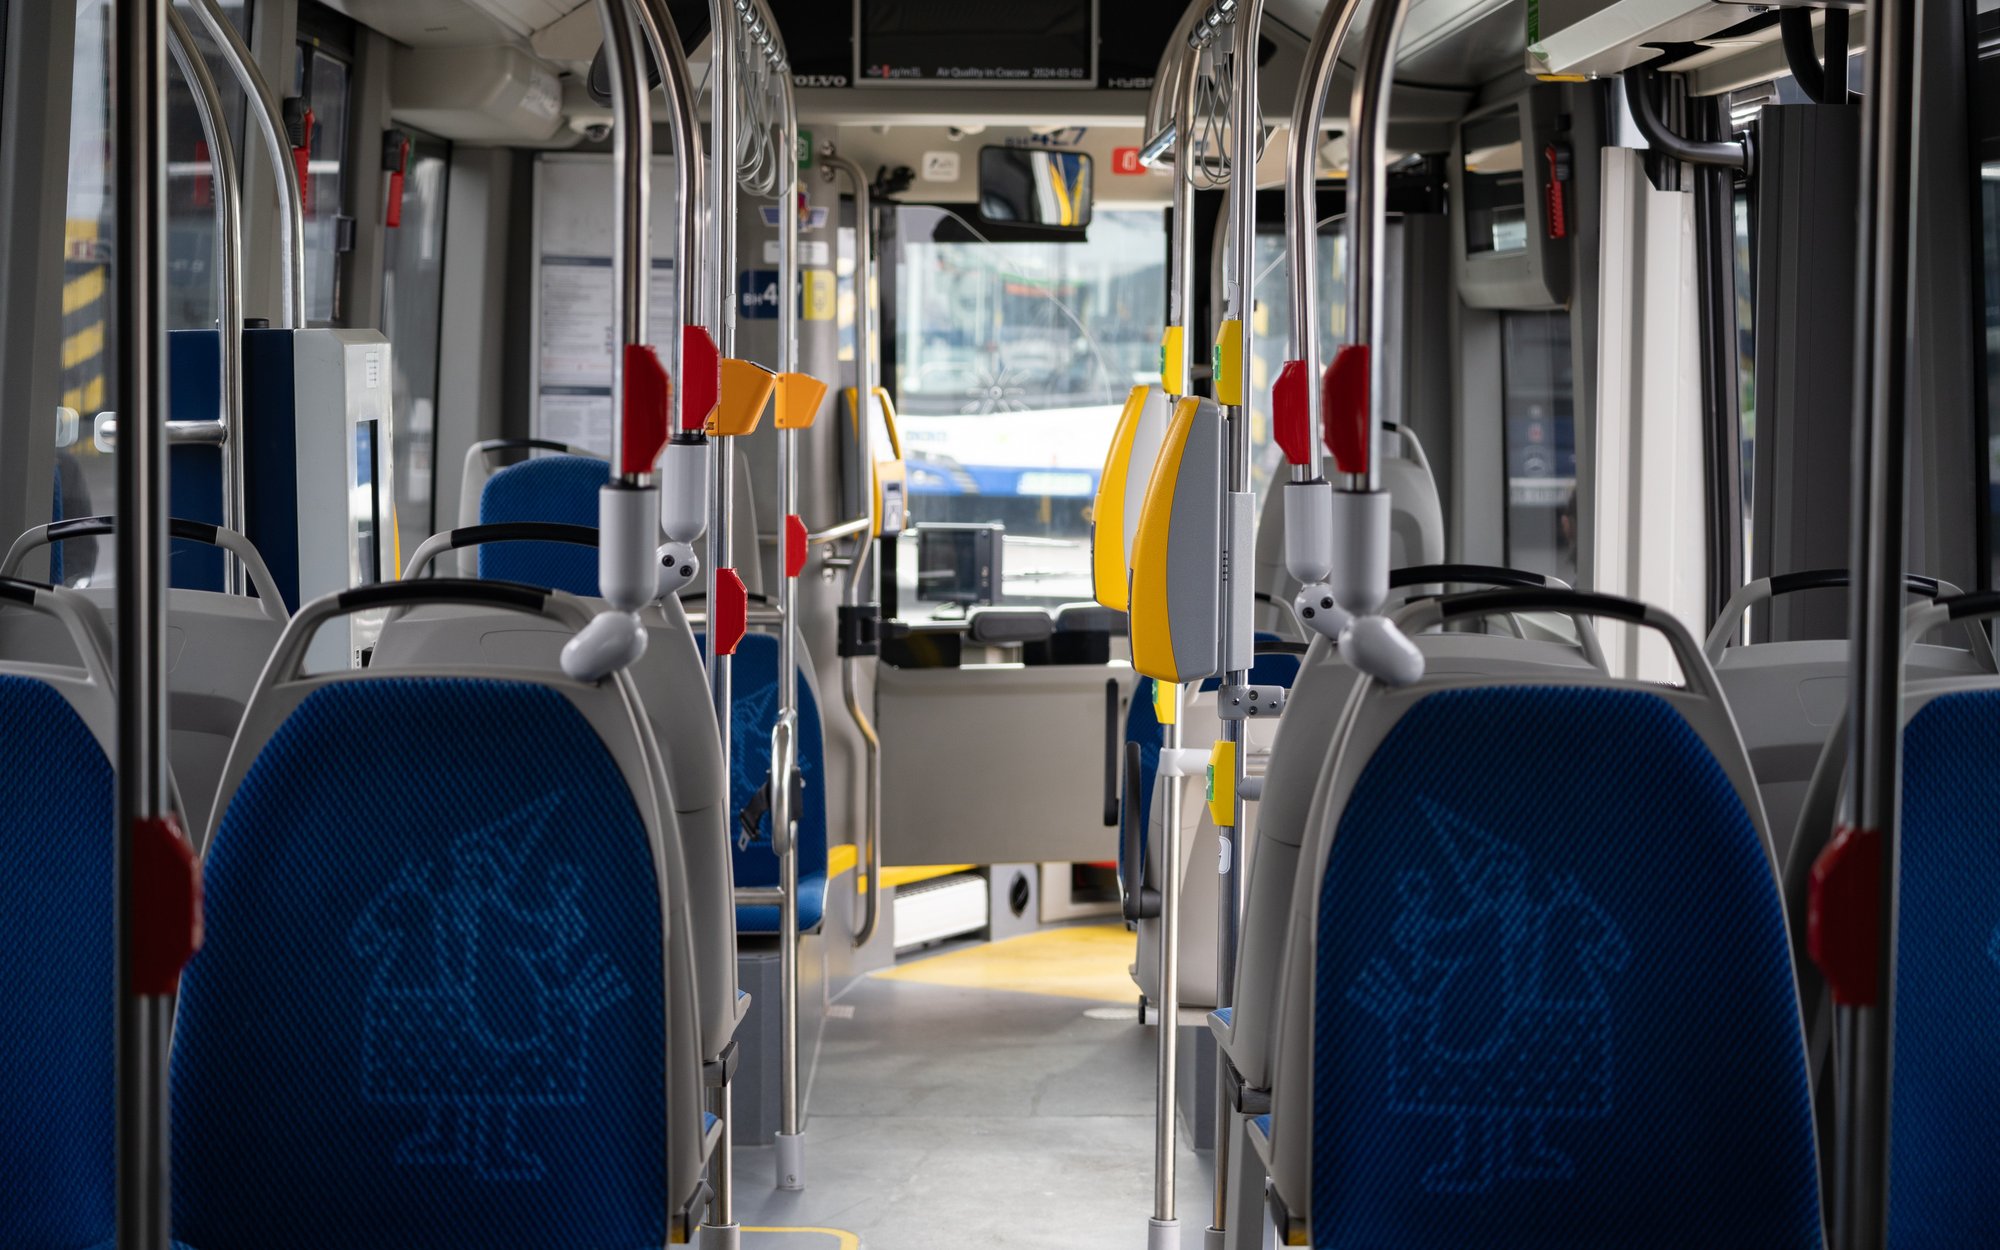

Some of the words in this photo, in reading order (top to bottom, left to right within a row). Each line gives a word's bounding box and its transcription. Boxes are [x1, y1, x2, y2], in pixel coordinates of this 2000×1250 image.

[936, 67, 950, 78] Air
[950, 66, 983, 79] Quality
[791, 74, 847, 88] OLVO
